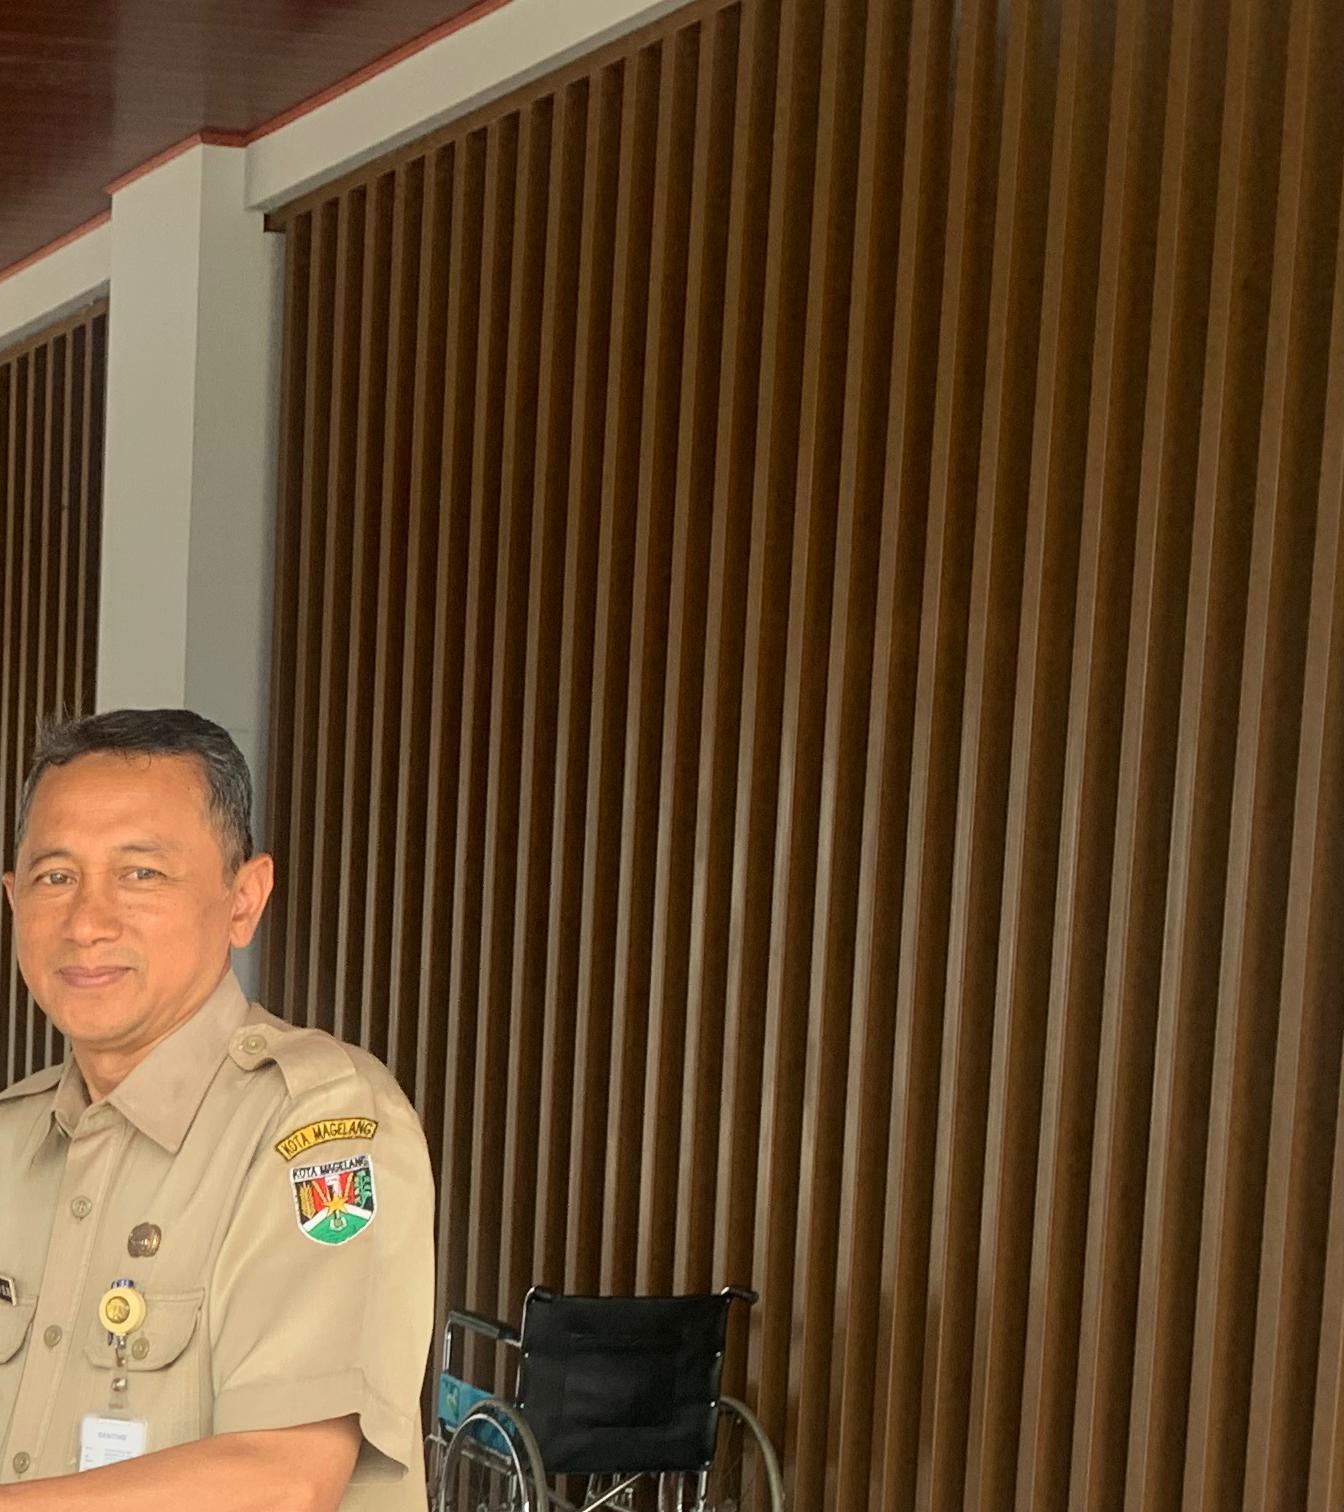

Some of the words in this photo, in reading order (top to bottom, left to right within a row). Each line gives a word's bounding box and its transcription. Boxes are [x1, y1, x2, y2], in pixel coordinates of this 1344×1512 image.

[280, 1132, 311, 1156] KOTA
[311, 1120, 373, 1141] MAGELANG
[292, 1167, 318, 1179] KOTA
[319, 1155, 369, 1175] MAGELANG
